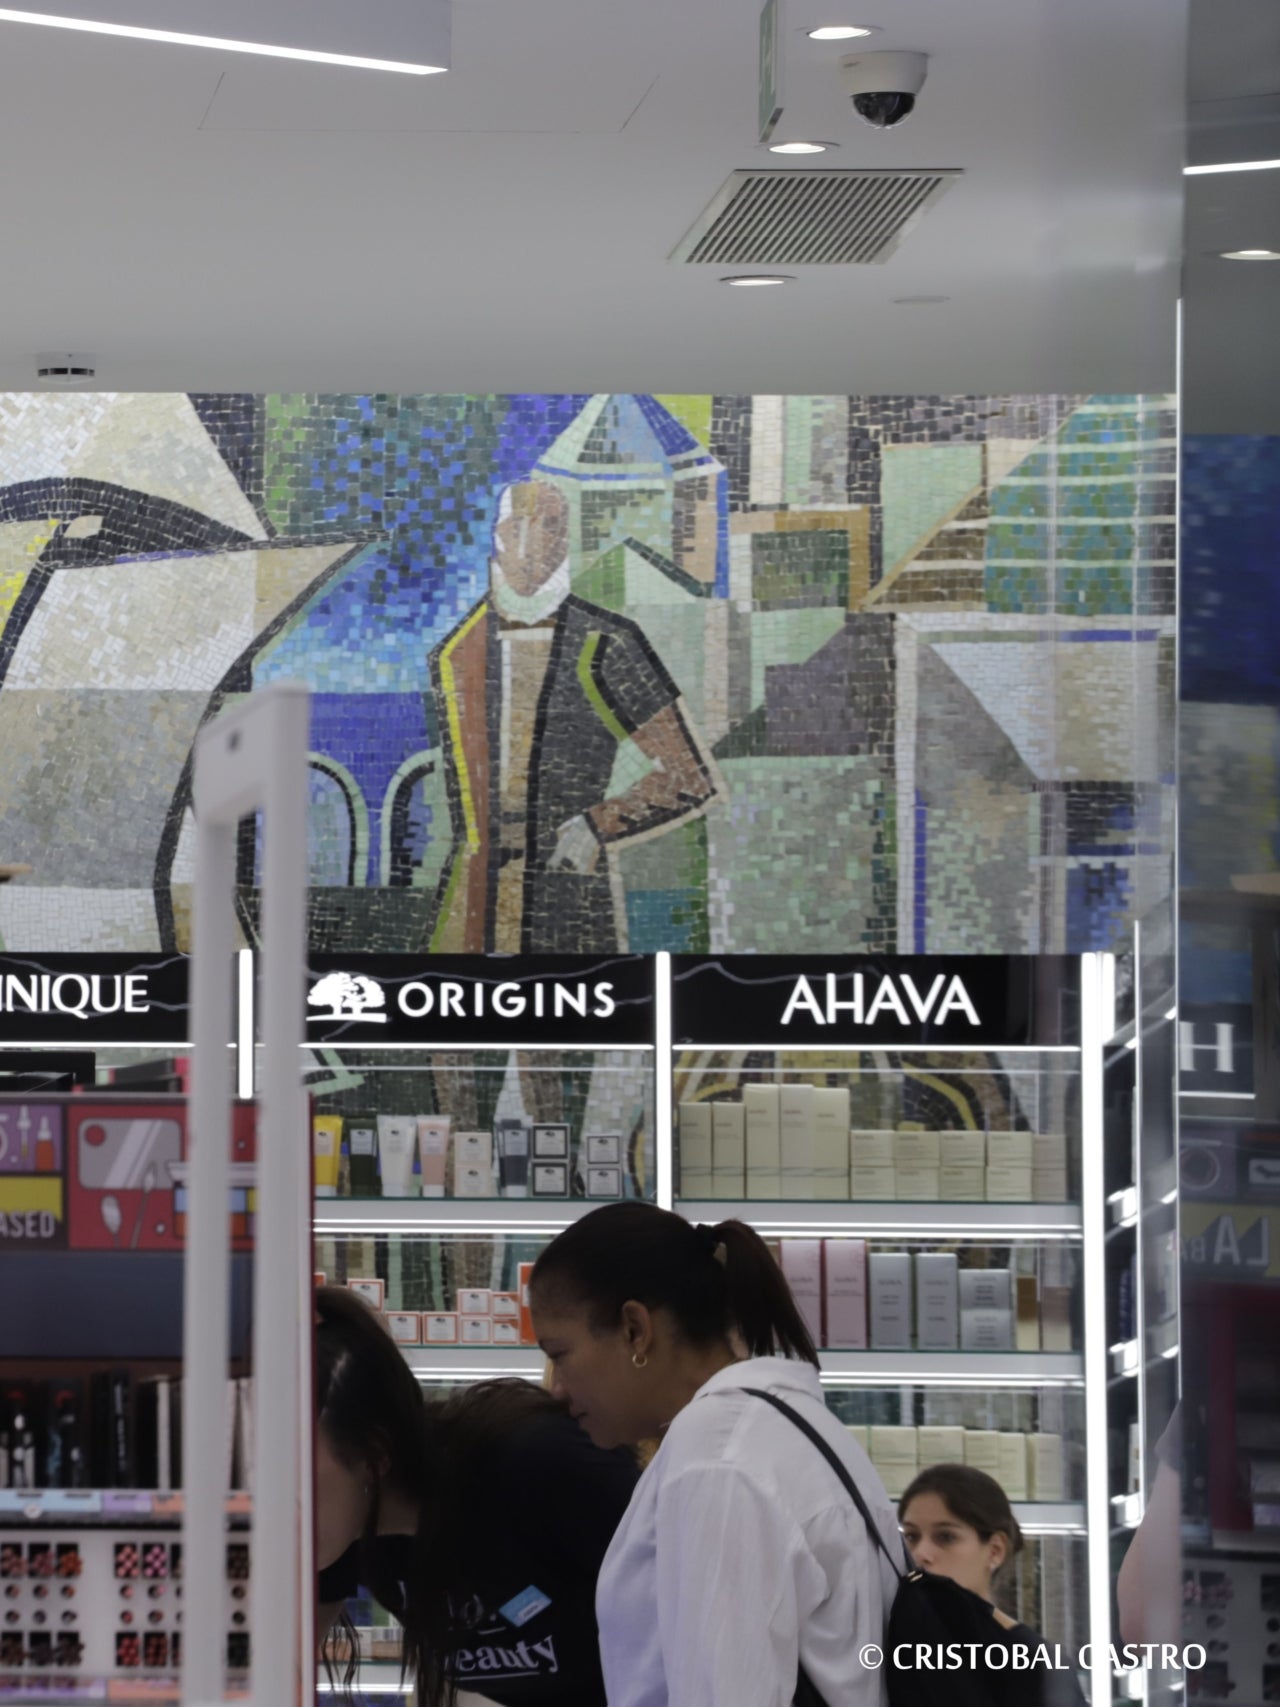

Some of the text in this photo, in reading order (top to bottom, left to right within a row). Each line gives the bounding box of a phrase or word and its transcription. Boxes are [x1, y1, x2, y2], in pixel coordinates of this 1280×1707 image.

[397, 981, 616, 1018] ORIGINS
[780, 972, 981, 1026] AHAVA
[444, 1635, 559, 1673] eauty
